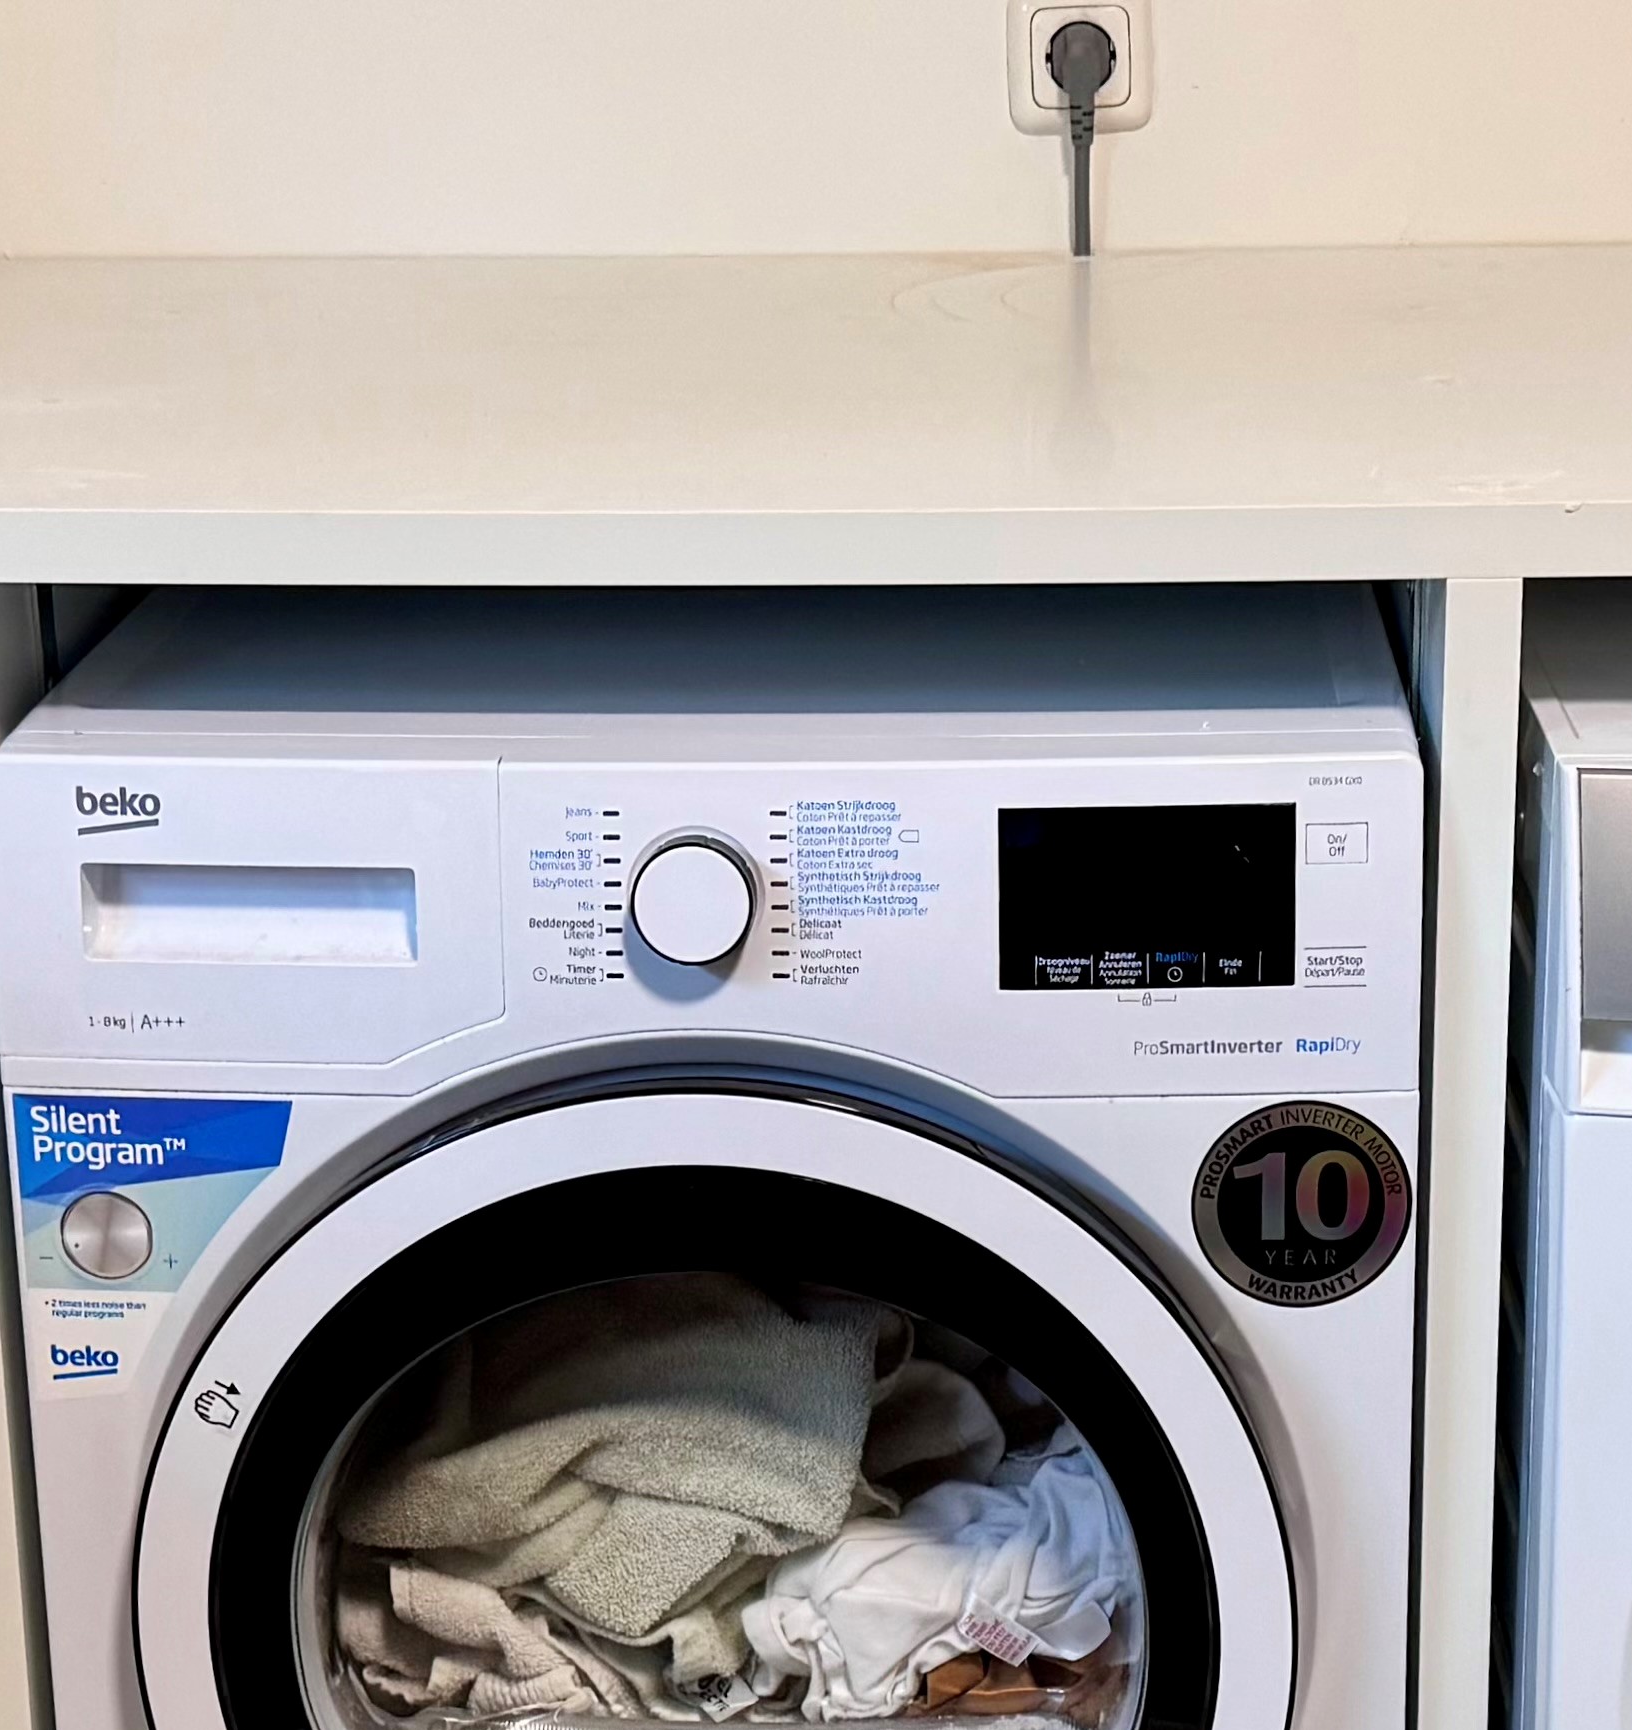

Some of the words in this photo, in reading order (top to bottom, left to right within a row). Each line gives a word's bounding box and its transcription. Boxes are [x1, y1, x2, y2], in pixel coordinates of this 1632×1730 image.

[75, 786, 161, 816] beko
[797, 801, 835, 810] Katoen
[566, 806, 592, 819] Jeans
[797, 812, 825, 822] Coton
[566, 830, 593, 842] Sport
[797, 825, 835, 835] Katoen
[838, 825, 892, 837] Kastdroog
[797, 836, 826, 846] Coton
[859, 837, 890, 847] porter
[1327, 833, 1347, 845] On/
[530, 849, 575, 859] Hemden
[797, 849, 835, 859] Katoen
[838, 848, 865, 858] Extra
[1329, 846, 1345, 857] Off
[529, 860, 576, 871] Chemises
[797, 860, 826, 870] Coton
[533, 877, 594, 889] BabyProtect
[798, 871, 861, 884] Synthetisch
[578, 901, 594, 911] Mix
[798, 896, 861, 907] Synthetisch
[864, 896, 918, 906] Kastdroog
[898, 907, 928, 917] porter
[529, 918, 595, 930] Beddengoed
[799, 919, 842, 929] Delicaat
[563, 930, 595, 940] Literie
[569, 947, 596, 959] Night
[800, 949, 862, 959] WoolProtect
[1307, 955, 1363, 967] Start/Stop
[567, 964, 597, 974] Timer
[800, 964, 860, 975] Verluchten
[550, 974, 597, 985] Minuterie
[140, 1014, 186, 1030] A+++
[1133, 1038, 1283, 1056] ProSmartInverter
[1296, 1037, 1362, 1055] RapiDry
[30, 1104, 122, 1135] Silent
[1199, 1113, 1274, 1200] PROSMART
[1280, 1107, 1365, 1141] INVERTER
[1363, 1136, 1402, 1196] MOTOR
[1233, 1150, 1371, 1241] 10
[1265, 1249, 1336, 1266] YEAR
[1248, 1268, 1358, 1301] WARRANTY
[101, 1301, 124, 1309] noise
[52, 1309, 82, 1318] regular
[51, 1344, 119, 1367] beko
